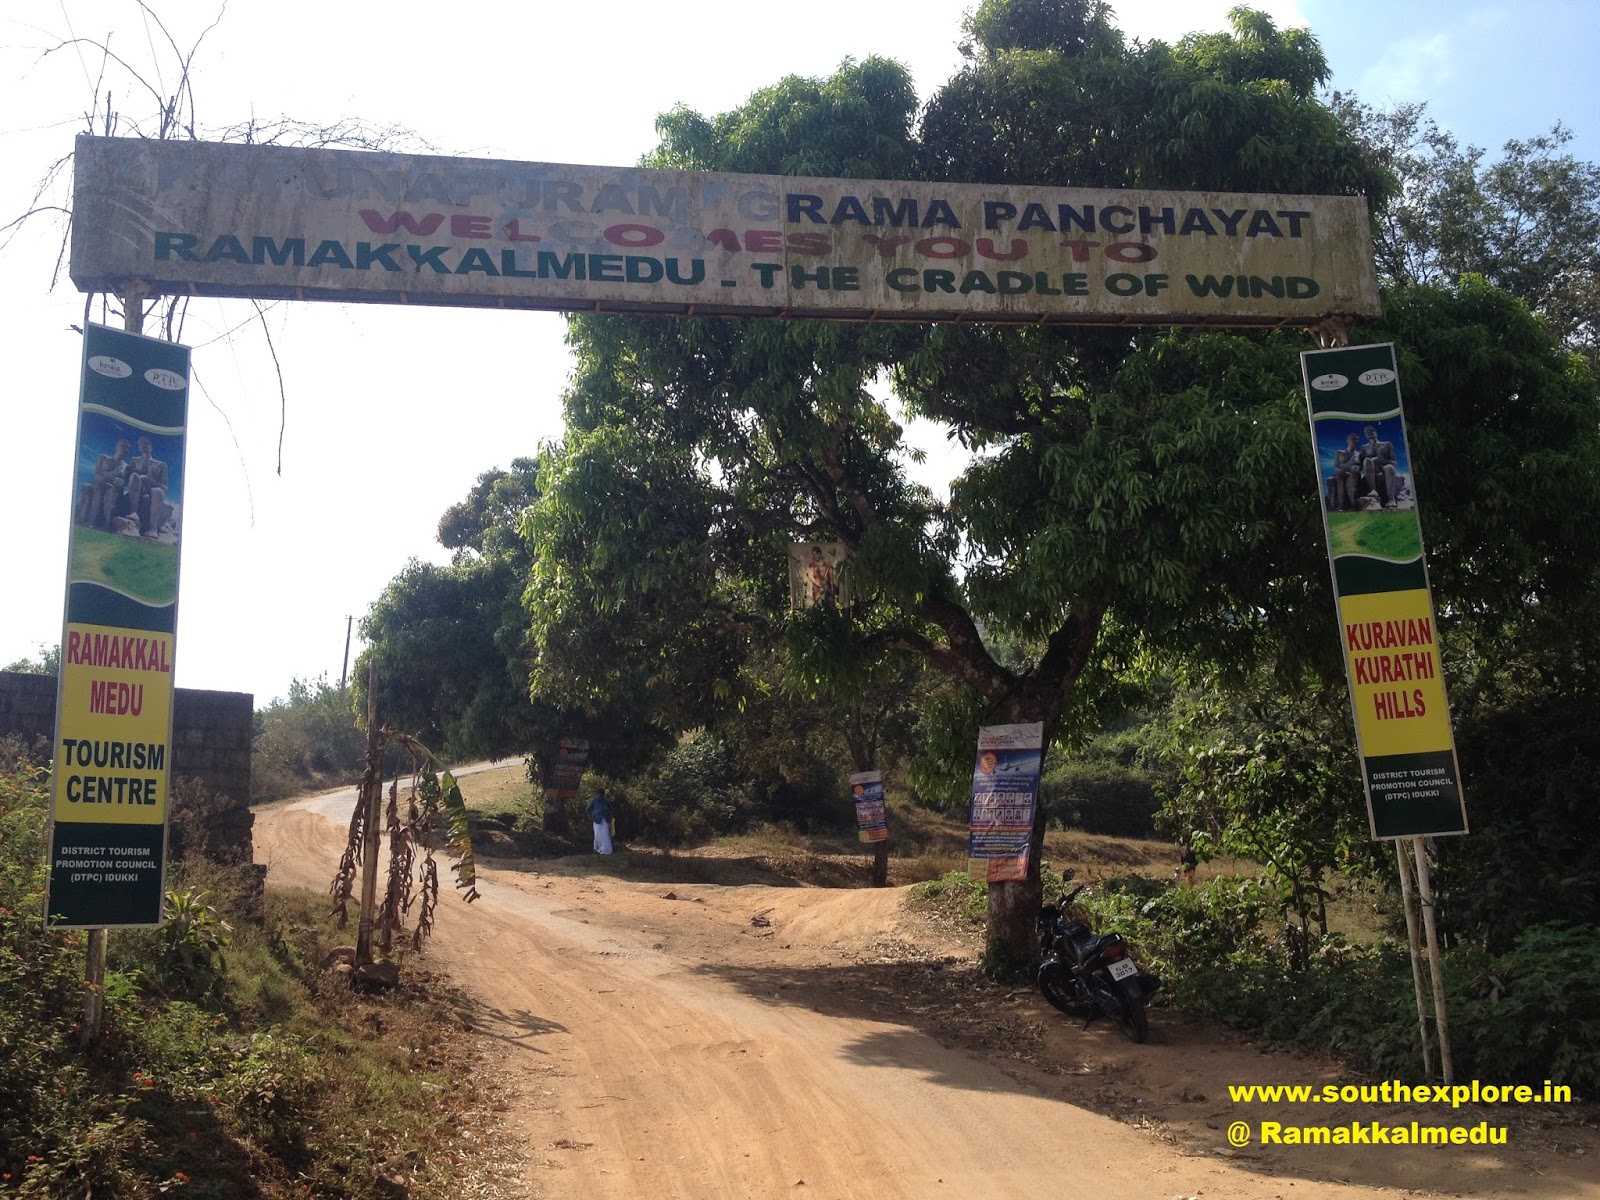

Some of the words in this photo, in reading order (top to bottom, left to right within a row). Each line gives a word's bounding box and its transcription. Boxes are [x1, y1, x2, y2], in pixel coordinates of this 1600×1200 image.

[984, 201, 1310, 238] PANCHAYAT
[860, 234, 1029, 261] YOU
[1060, 239, 1158, 263] TO
[153, 231, 706, 286] RAMAKKALMEDU
[750, 262, 860, 291] THE
[885, 267, 1090, 296] CRADLE
[1104, 273, 1169, 297] OF
[1185, 273, 1320, 299] WIND
[1346, 617, 1432, 651] KURAVAN
[67, 631, 170, 672] RAMAKKAL
[1354, 651, 1434, 685] KURATHI
[90, 680, 143, 717] MEDU
[1374, 689, 1426, 720] HILLS
[62, 738, 165, 770] TOURISM
[1371, 781, 1416, 791] PROMOTION
[1418, 778, 1453, 787] COUNCIL
[1373, 770, 1408, 780] DISTRICT
[1410, 767, 1446, 777] TOURISM
[66, 775, 157, 805] CENTRE
[1385, 792, 1410, 801] (DTPC)
[1412, 789, 1440, 798] IDUKKI
[56, 860, 113, 868] PROMOTION
[115, 861, 156, 869] COUNCIL
[61, 846, 106, 855] DISTRICT
[109, 847, 150, 856] TOURISM
[70, 873, 103, 882] (DTPC)
[105, 874, 138, 882] IDUKKI
